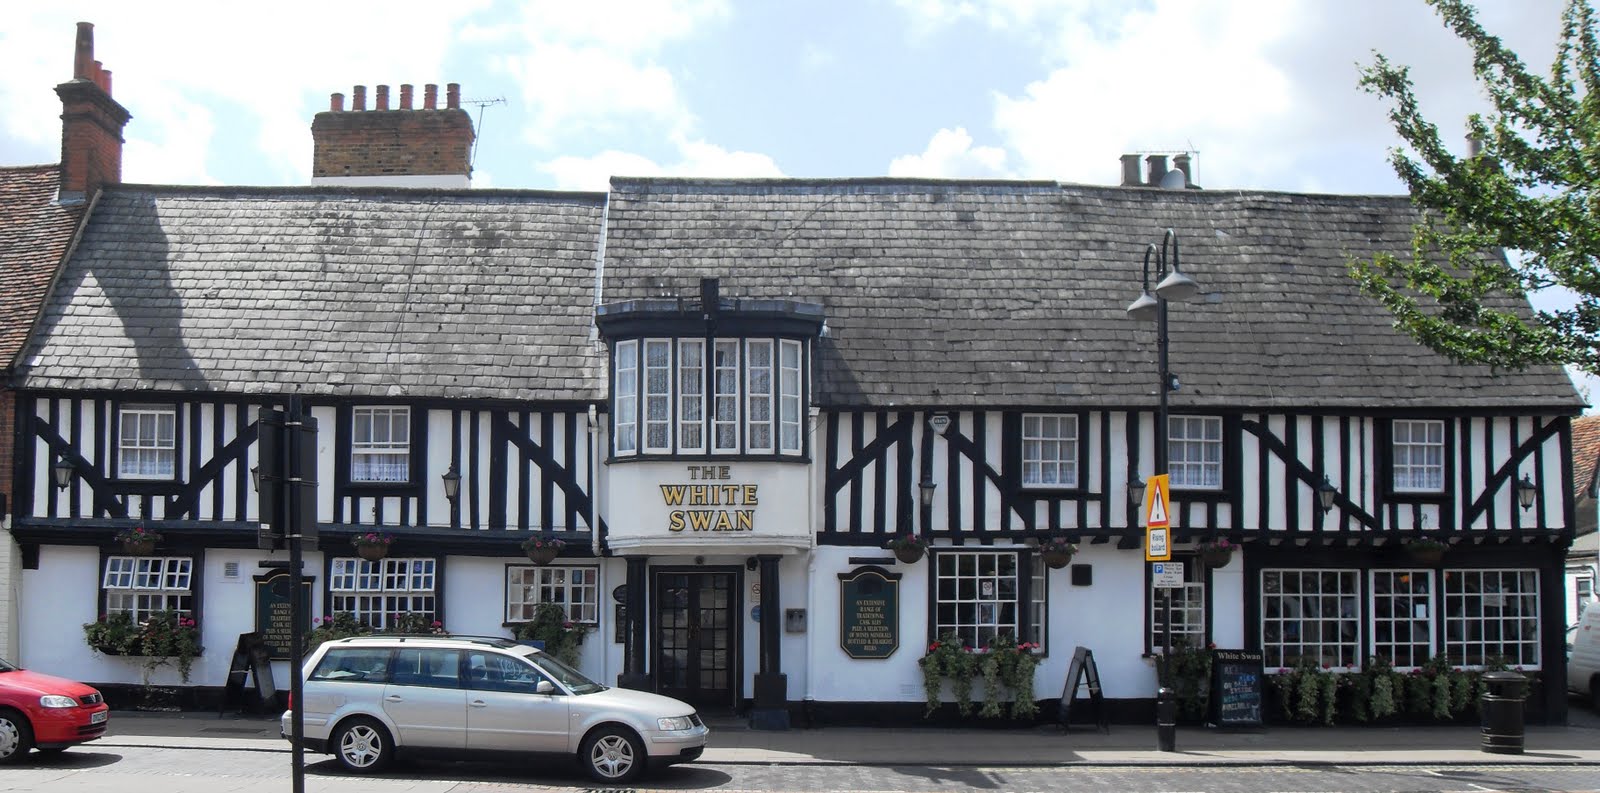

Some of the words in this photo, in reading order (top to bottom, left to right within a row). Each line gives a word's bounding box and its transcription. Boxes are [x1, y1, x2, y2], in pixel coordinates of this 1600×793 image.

[688, 466, 731, 480] THE
[659, 484, 758, 506] WHITE
[669, 510, 755, 532] SWAN
[1156, 565, 1162, 573] P
[1217, 652, 1240, 660] White
[1240, 652, 1261, 660] Swan
